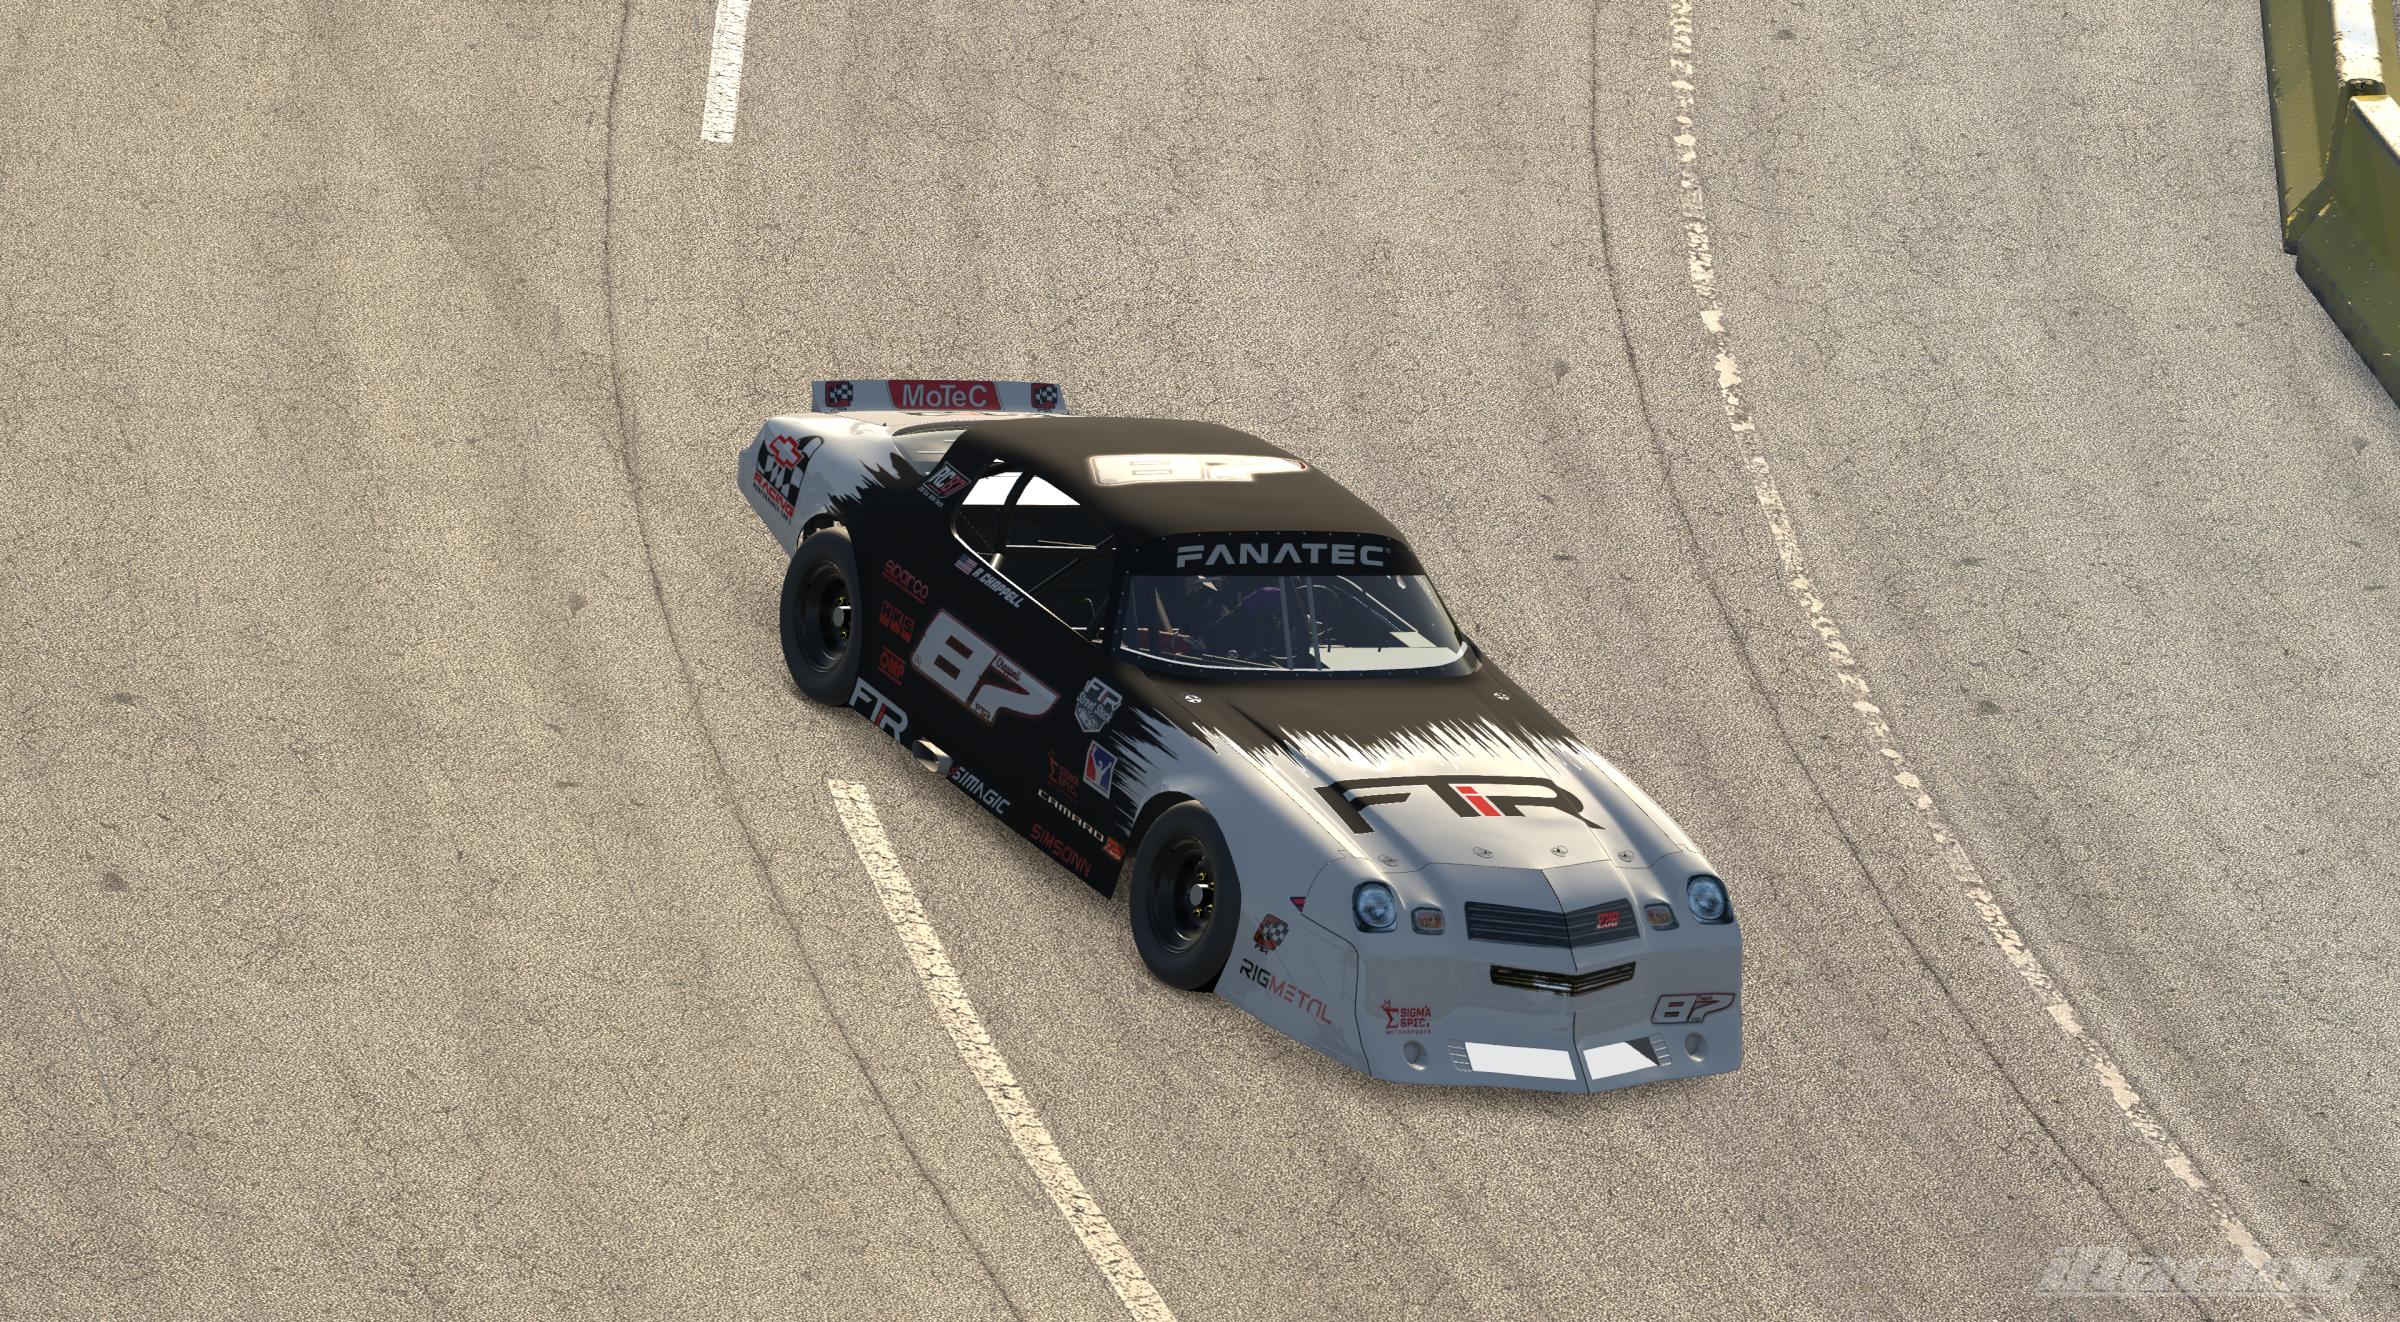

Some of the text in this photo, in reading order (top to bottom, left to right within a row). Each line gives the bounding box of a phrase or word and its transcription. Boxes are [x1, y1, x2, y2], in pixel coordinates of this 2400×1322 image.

[903, 384, 988, 408] MoTeC
[754, 473, 795, 518] RACING
[1177, 543, 1384, 568] FANATEC
[884, 560, 929, 600] sparco
[879, 651, 905, 680] OMP
[911, 608, 1062, 728] 87
[951, 766, 1011, 815] SIMAGIC
[1038, 788, 1104, 842] CAMARO
[1240, 958, 1332, 1024] RIGMETAL
[1650, 993, 1735, 1024] 87
[1400, 1007, 1432, 1018] SIGMA
